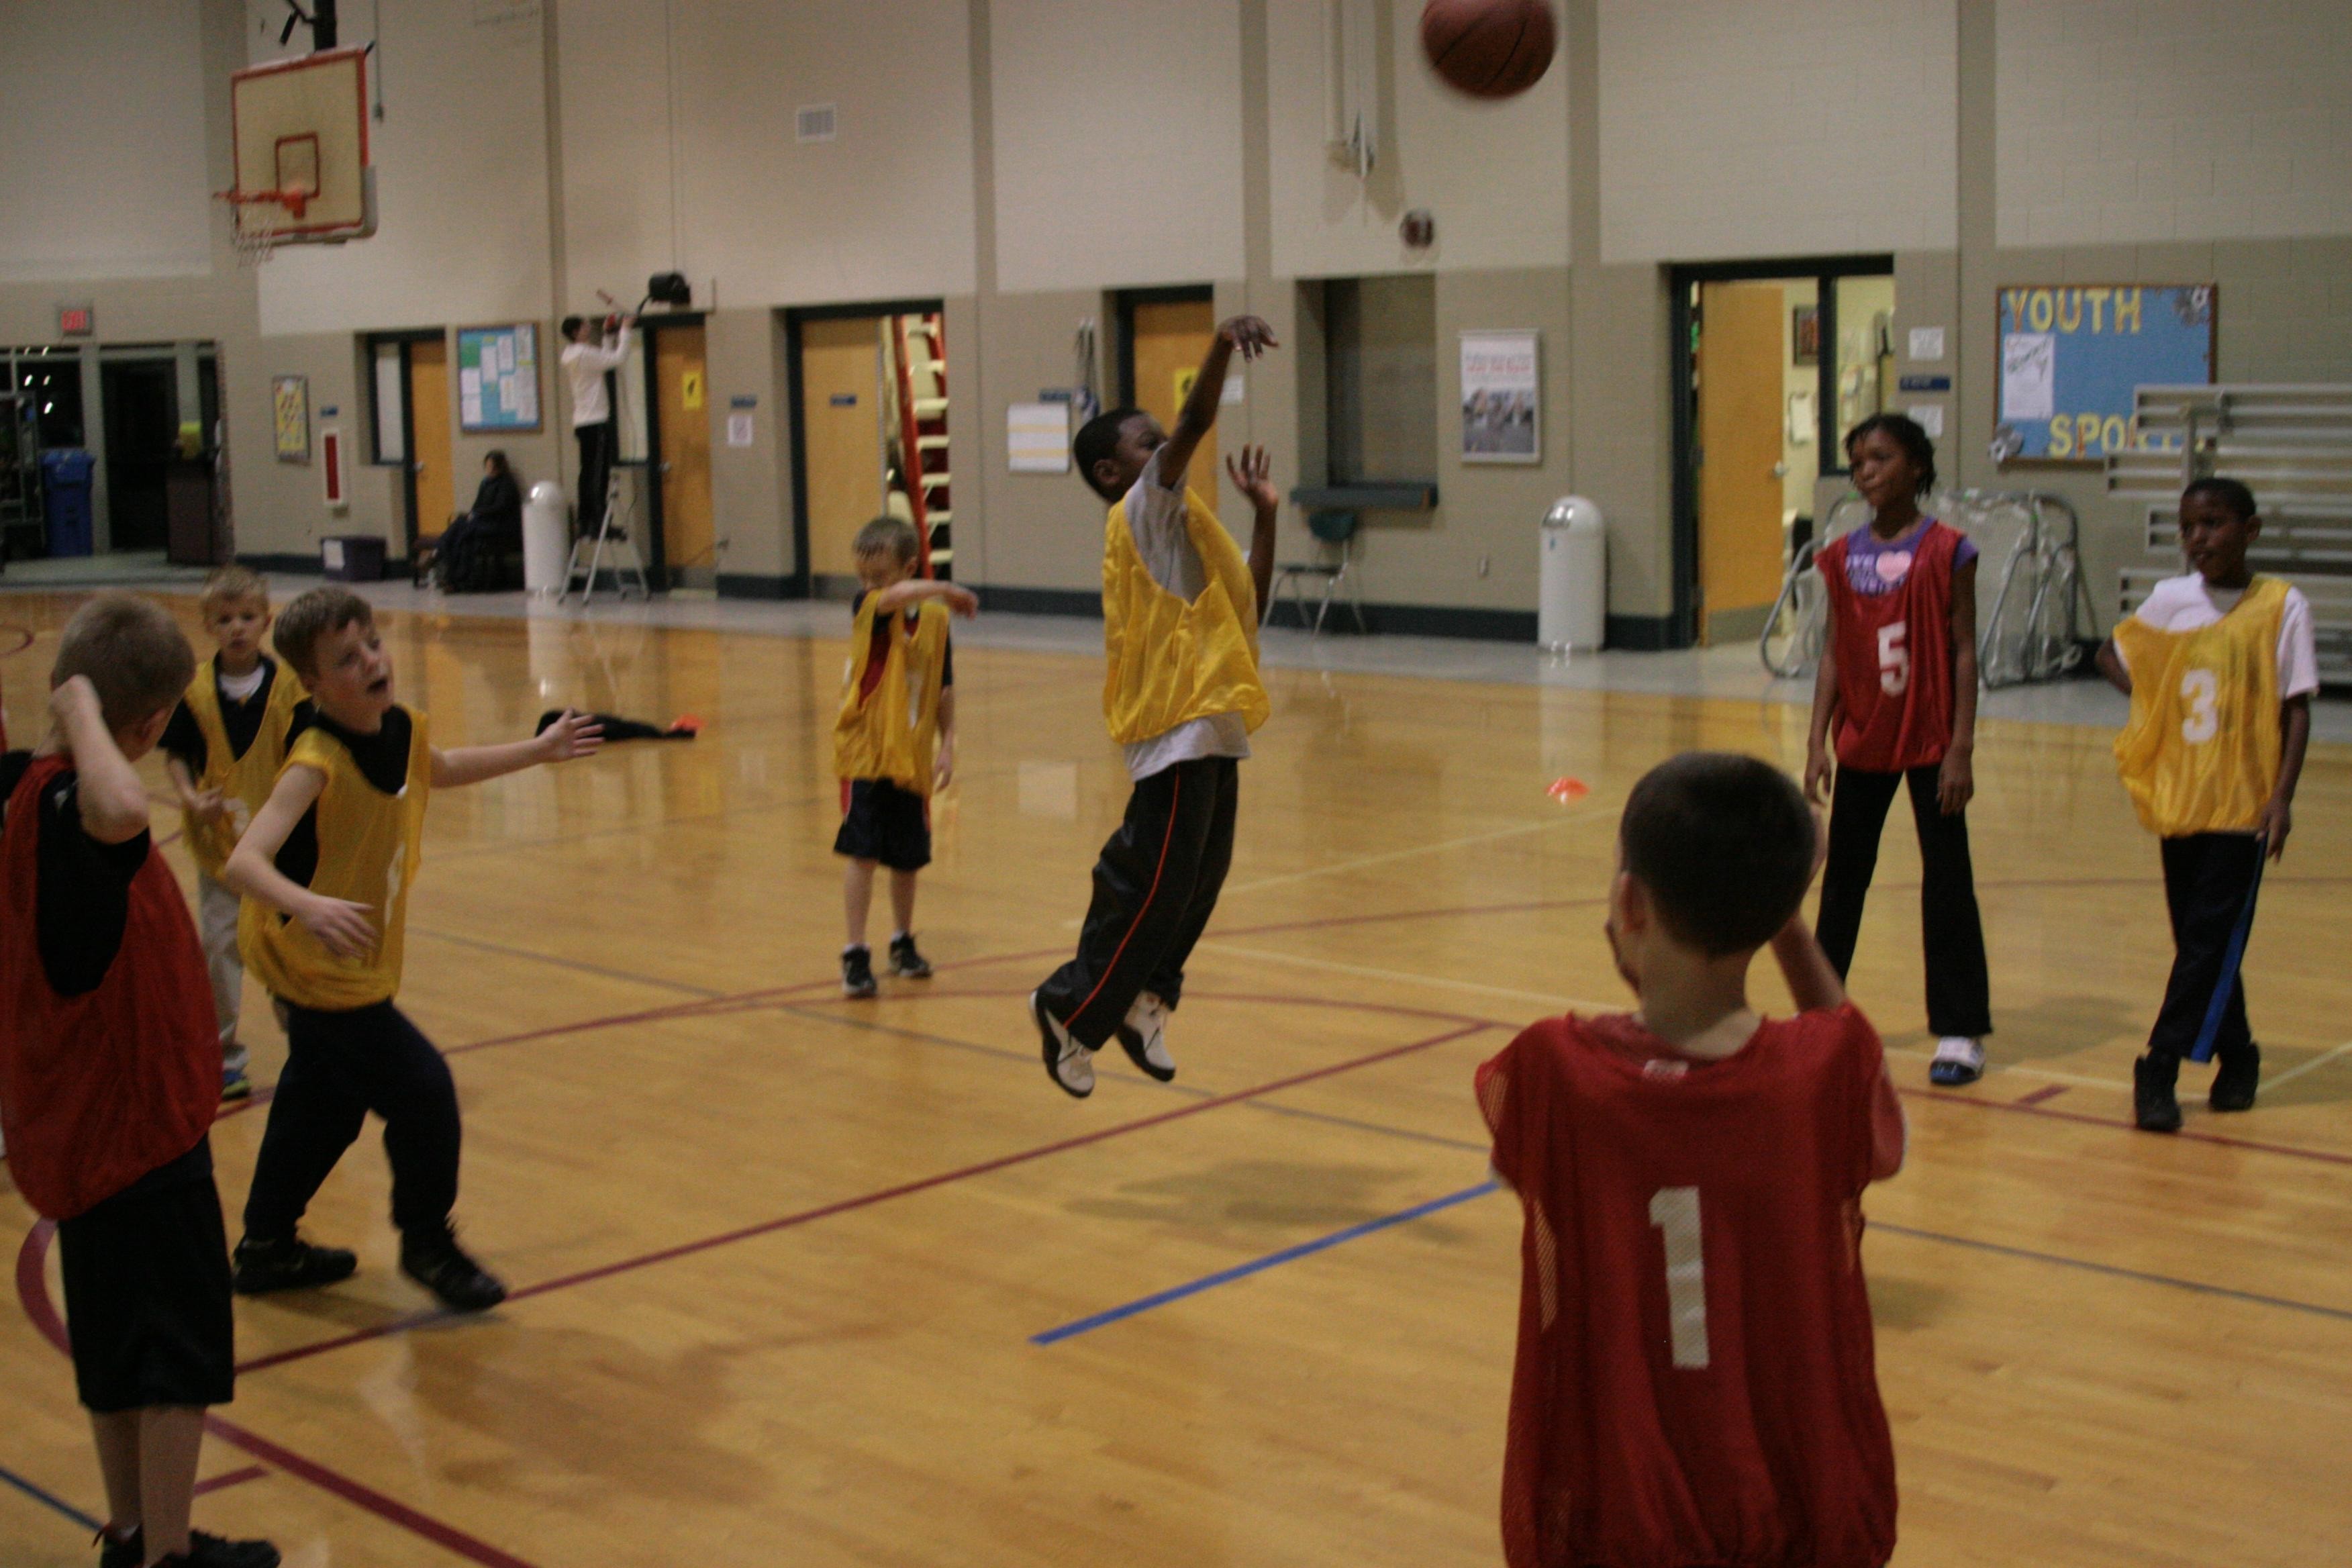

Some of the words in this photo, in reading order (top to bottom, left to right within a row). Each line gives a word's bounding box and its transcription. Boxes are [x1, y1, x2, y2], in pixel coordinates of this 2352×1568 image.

[2006, 287, 2141, 334] YOUTH
[1877, 620, 1910, 697] 5
[2181, 668, 2218, 744] 3
[1649, 1185, 1710, 1369] 1
